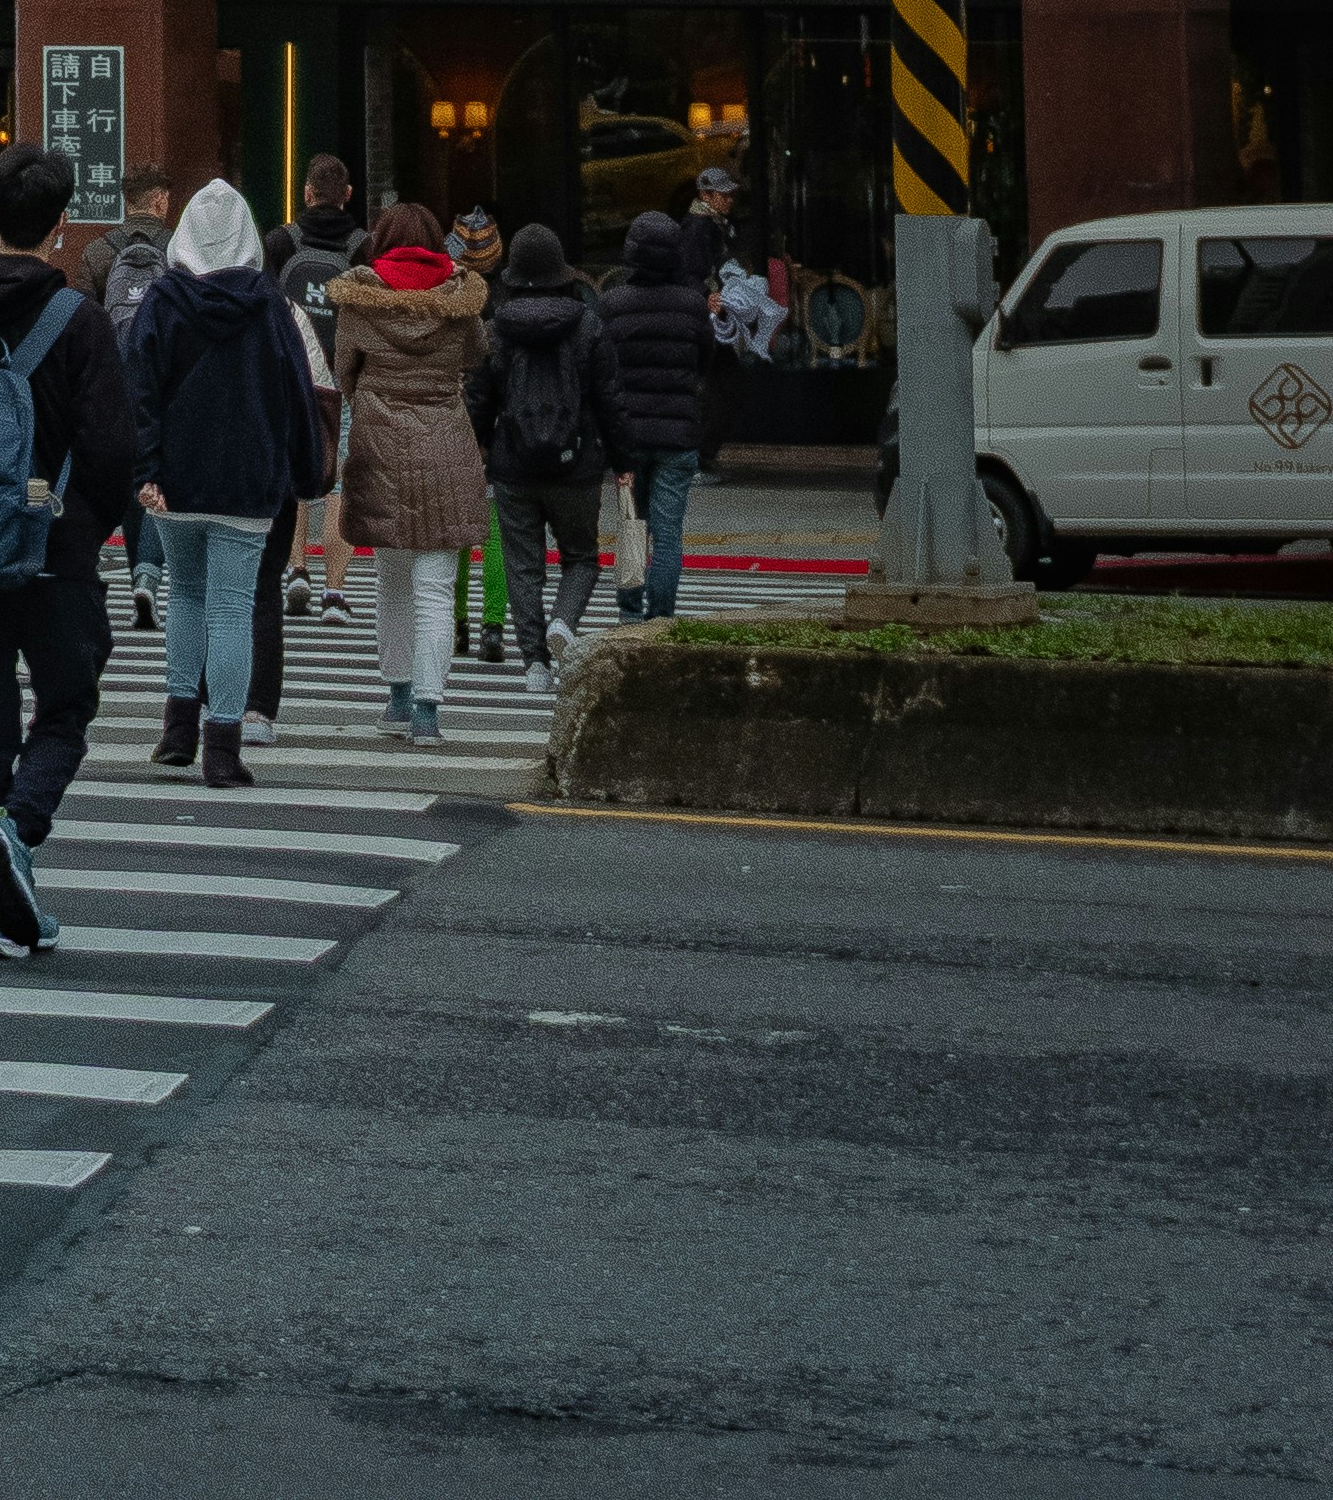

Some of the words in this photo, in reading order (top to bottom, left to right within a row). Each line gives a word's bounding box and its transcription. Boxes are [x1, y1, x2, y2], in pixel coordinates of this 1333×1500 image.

[51, 52, 81, 188] 請下車牽
[86, 54, 117, 188] 自行車
[85, 191, 117, 205] Your
